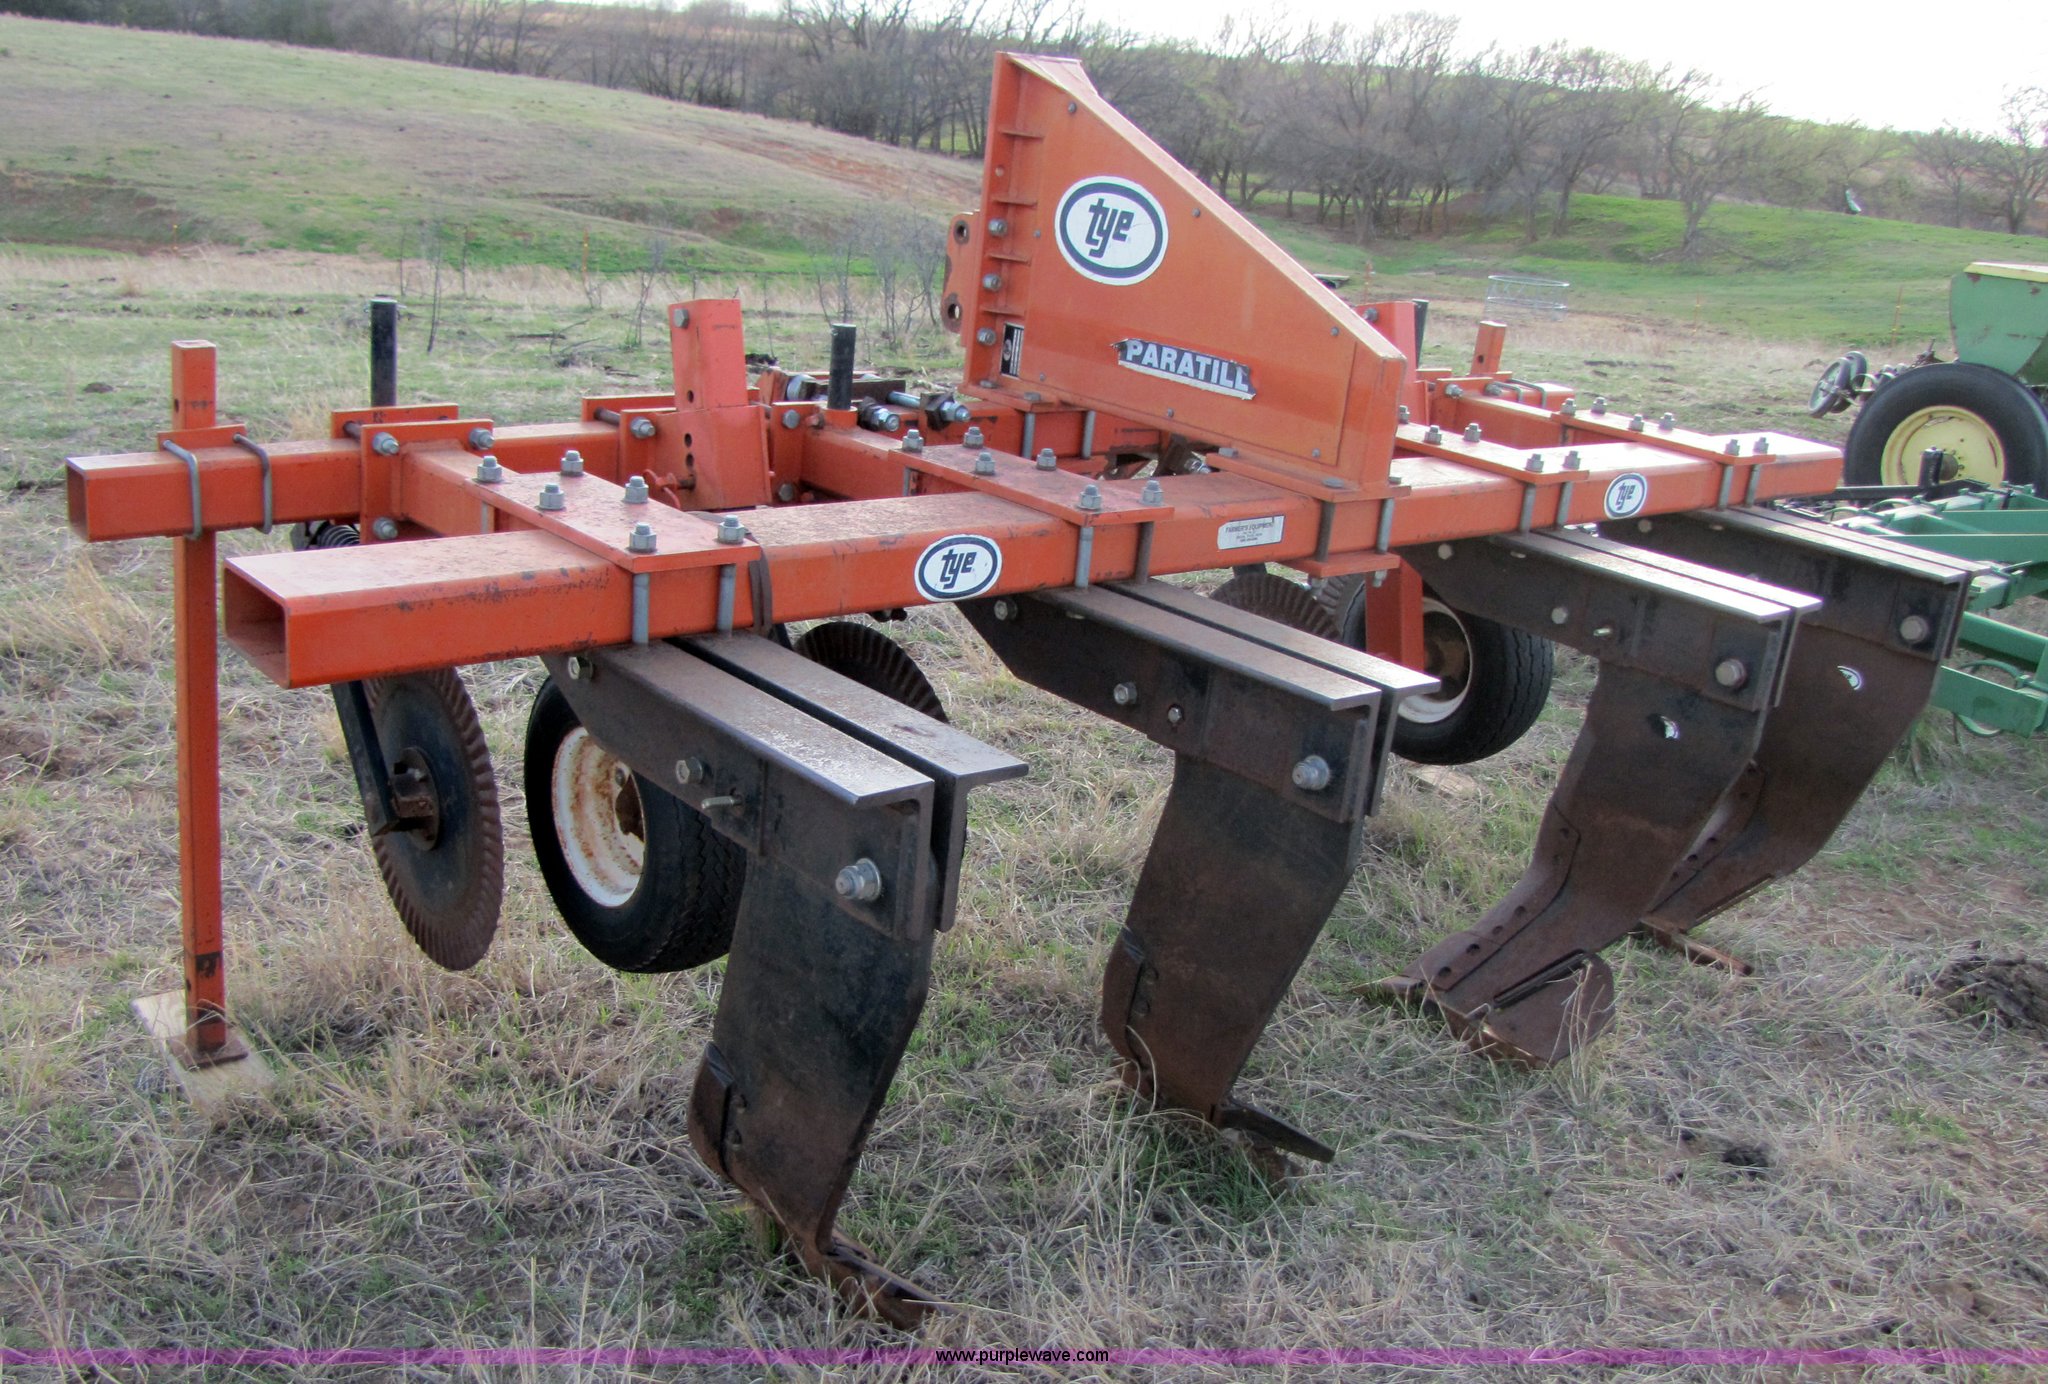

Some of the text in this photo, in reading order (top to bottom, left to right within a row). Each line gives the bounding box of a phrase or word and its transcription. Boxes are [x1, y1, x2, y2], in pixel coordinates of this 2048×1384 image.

[1085, 198, 1134, 258] tye
[1125, 339, 1249, 392] PARATILL
[1615, 482, 1636, 511] tye
[940, 548, 977, 590] tye
